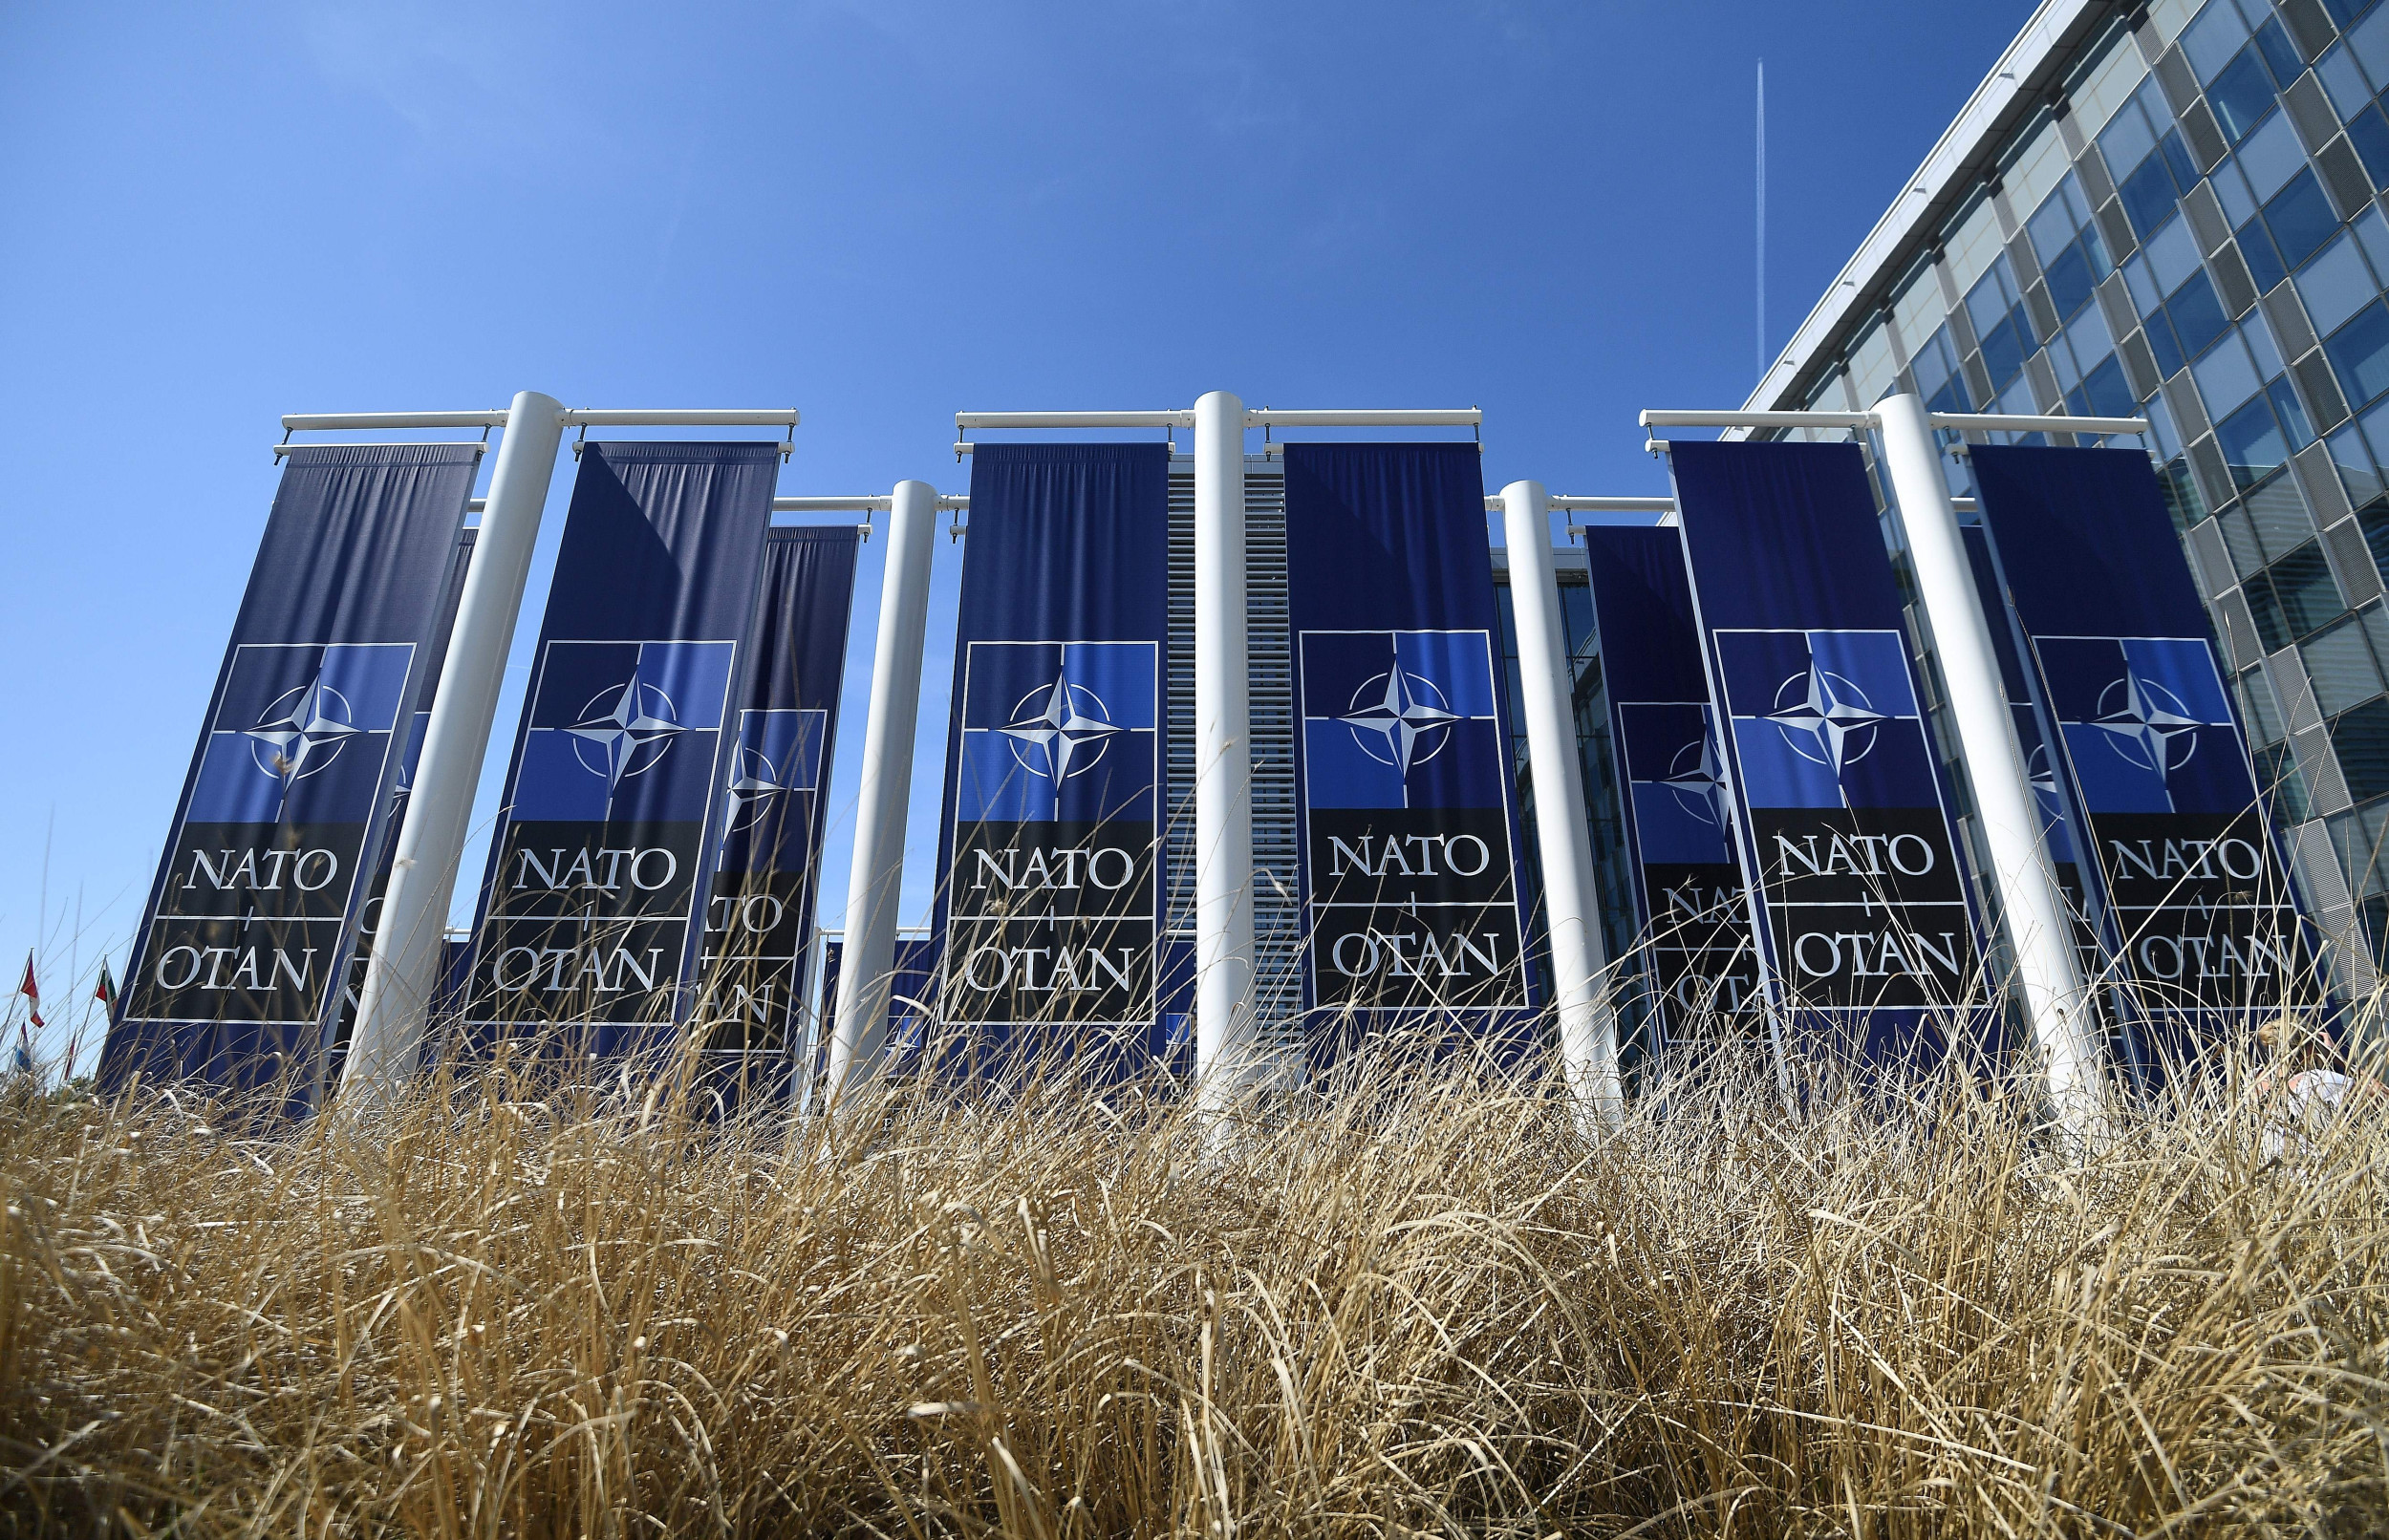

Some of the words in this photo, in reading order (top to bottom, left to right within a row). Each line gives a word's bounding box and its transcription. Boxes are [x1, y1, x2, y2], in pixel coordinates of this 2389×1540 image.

[182, 847, 338, 891] NATO
[511, 847, 678, 891] NATO
[970, 847, 1134, 891] NATO
[1327, 834, 1490, 877] NATO
[1772, 834, 1934, 876] NATO
[2108, 838, 2261, 880] NATO
[704, 894, 783, 932] TO
[1662, 887, 1752, 925] NA
[156, 945, 317, 992] OTAN
[492, 946, 664, 993] OTAN
[965, 946, 1134, 992] OTAN
[1331, 932, 1499, 977] OTAN
[1794, 932, 1959, 977] OTAN
[2140, 933, 2292, 979] OTAN
[690, 982, 776, 1023] AN
